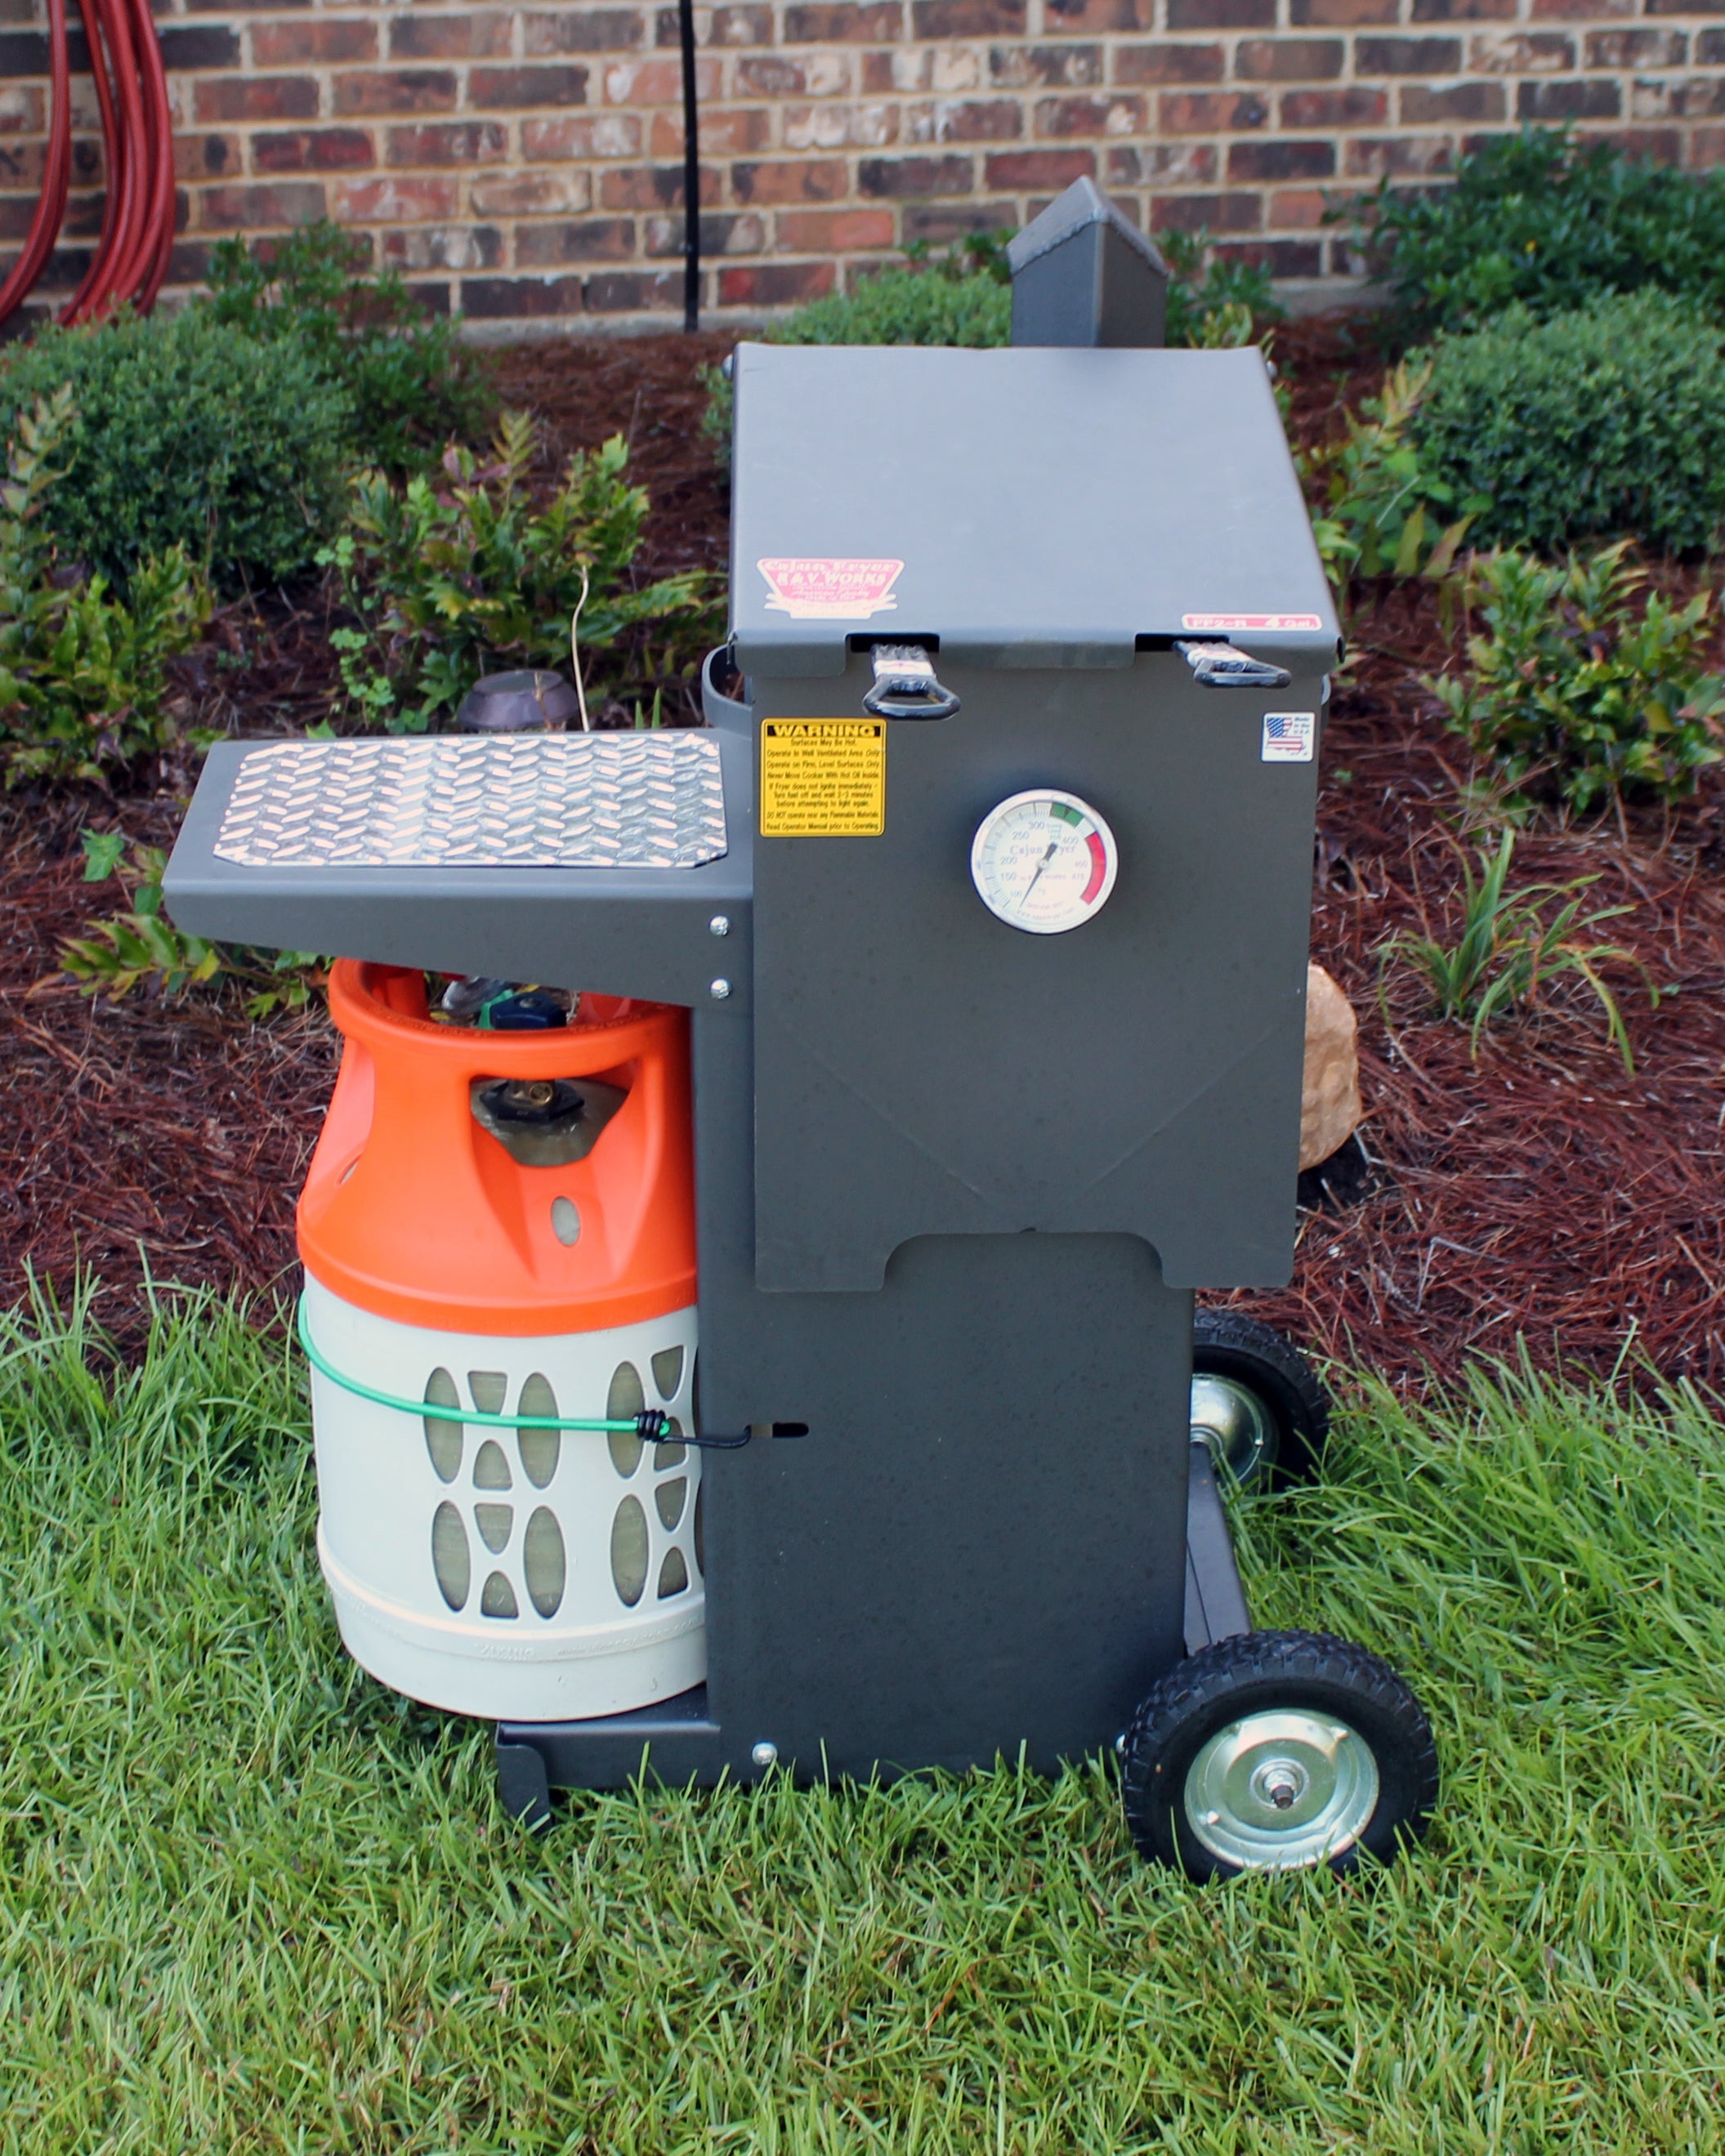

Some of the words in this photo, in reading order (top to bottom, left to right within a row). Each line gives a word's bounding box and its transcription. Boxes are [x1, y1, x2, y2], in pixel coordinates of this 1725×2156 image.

[764, 560, 826, 572] Cajun
[824, 573, 887, 586] WORKS
[1264, 617, 1280, 628] 4
[775, 725, 875, 736] WARNING
[791, 738, 817, 746] Surfaces
[820, 738, 832, 748] May
[834, 738, 842, 746] Be
[766, 748, 791, 757] Operate
[802, 748, 814, 757] Well
[766, 760, 790, 769] Operate
[819, 760, 835, 768] Level
[837, 760, 863, 768] Surfaces
[775, 783, 790, 791] Fryer
[820, 783, 836, 791] ignite
[838, 783, 872, 791] immediately
[798, 800, 829, 808] attempting
[838, 800, 851, 808] light
[782, 822, 807, 831] Operator
[829, 822, 842, 831] prior
[1028, 821, 1045, 830] 300
[1012, 831, 1030, 840] 250
[1061, 837, 1079, 845] 400
[1009, 844, 1043, 856] Cajun
[1000, 856, 1017, 865] 200
[1000, 873, 1017, 881] 150
